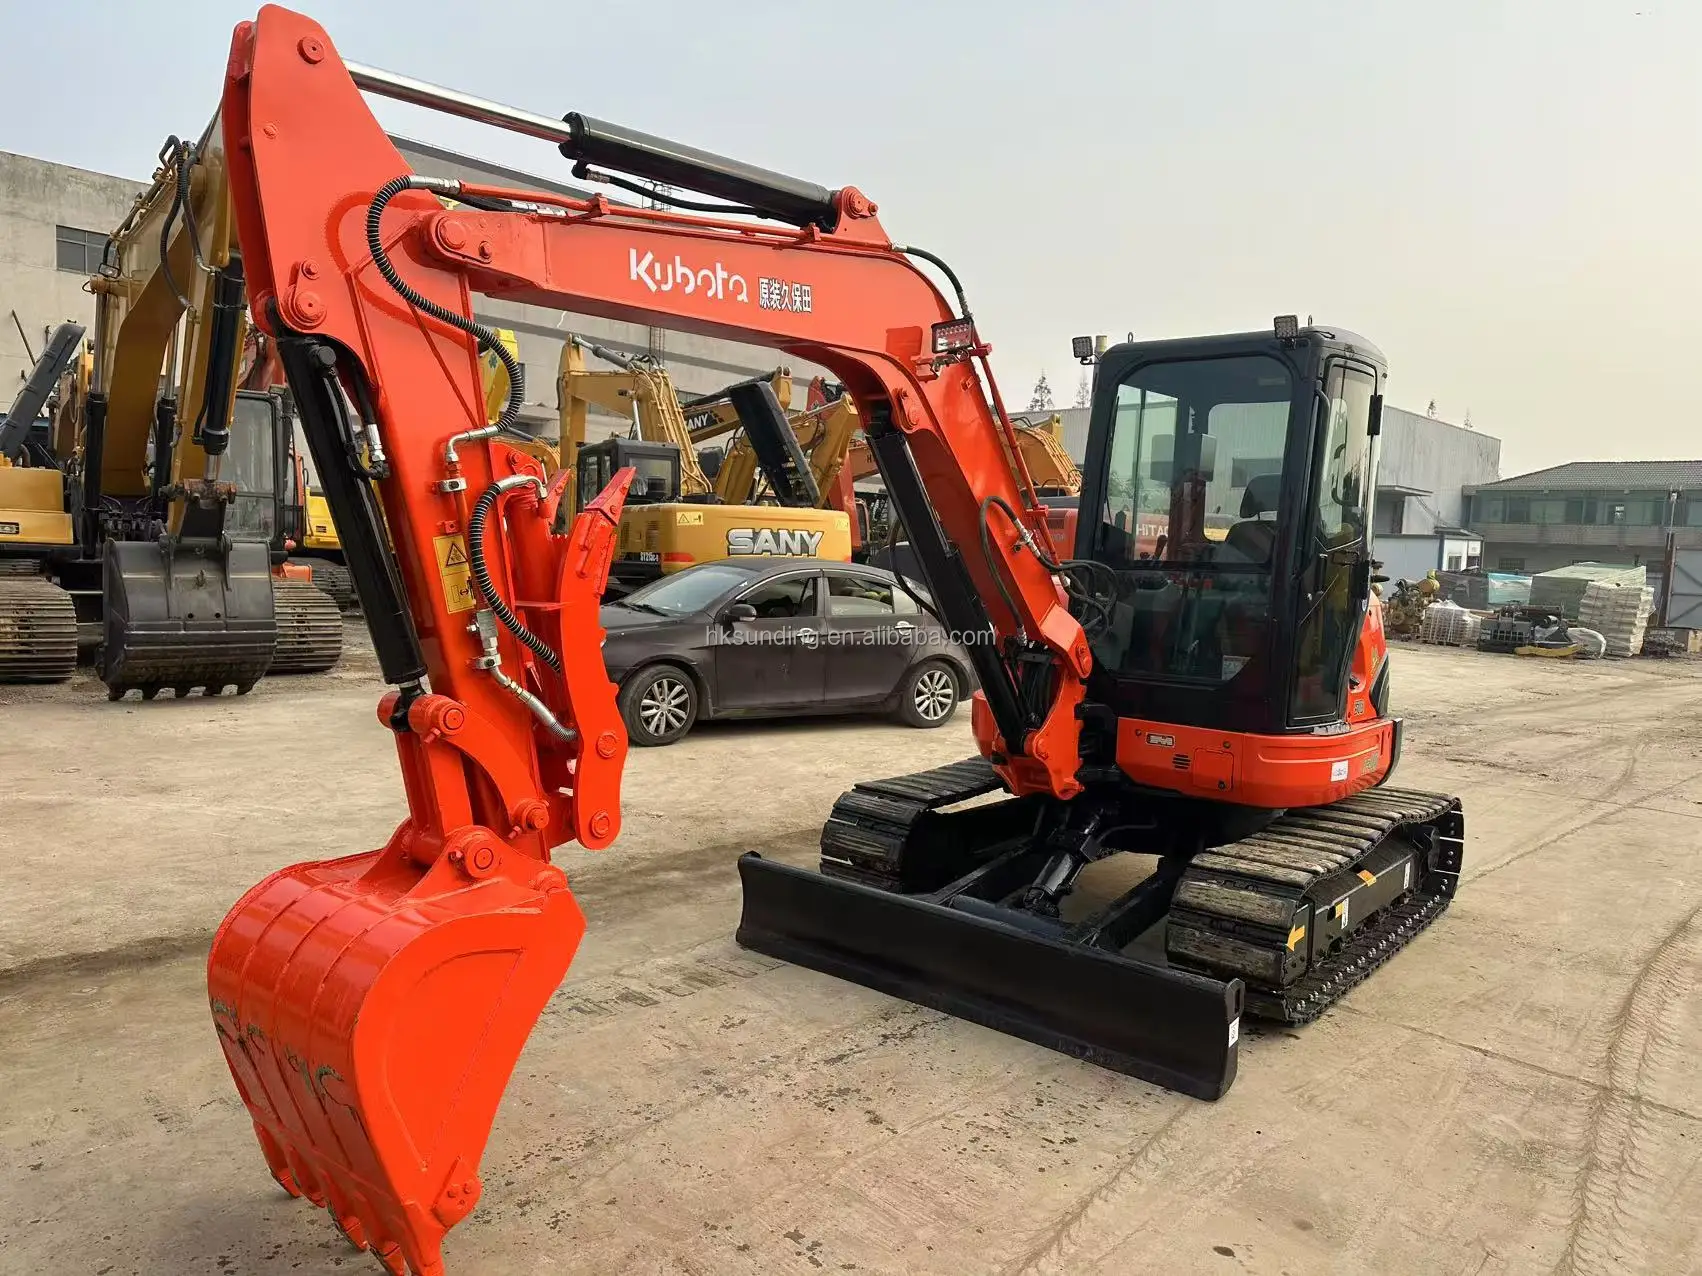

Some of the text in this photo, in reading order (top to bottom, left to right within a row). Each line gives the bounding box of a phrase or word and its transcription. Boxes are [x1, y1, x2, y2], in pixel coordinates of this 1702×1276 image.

[629, 247, 749, 303] Kubota
[758, 276, 813, 313] 原装久保田
[687, 413, 709, 430] ANY
[727, 528, 824, 557] SANY
